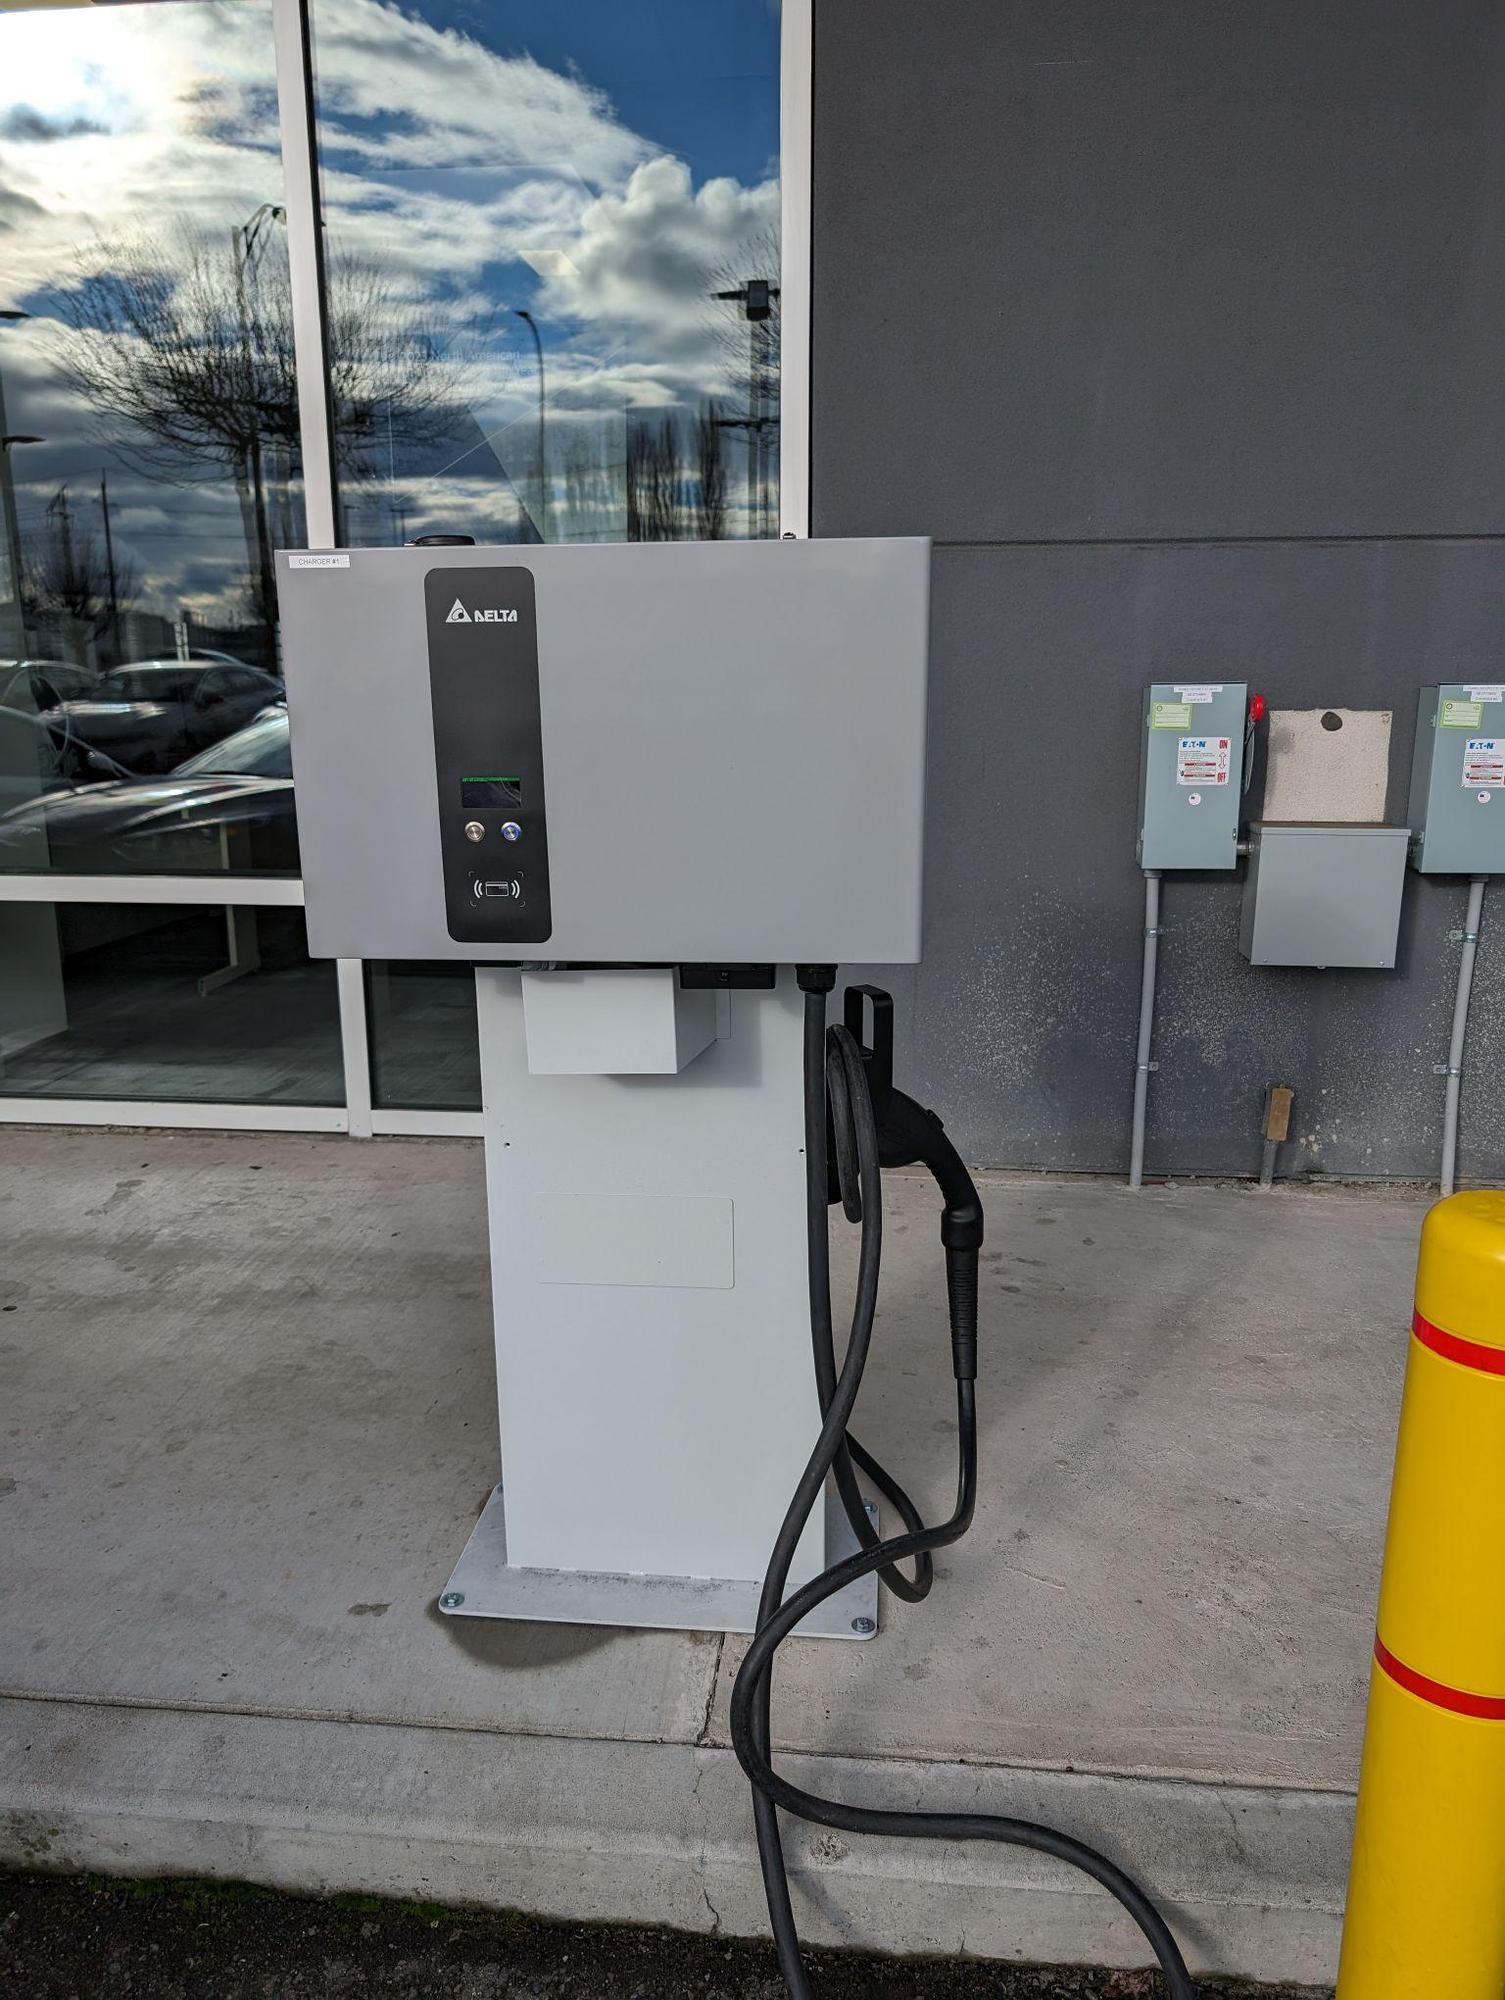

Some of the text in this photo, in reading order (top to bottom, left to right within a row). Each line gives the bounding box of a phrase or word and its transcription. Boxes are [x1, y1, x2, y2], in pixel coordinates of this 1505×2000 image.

[469, 351, 520, 361] American
[299, 558, 331, 566] CHARGER
[474, 609, 518, 622] DELTA
